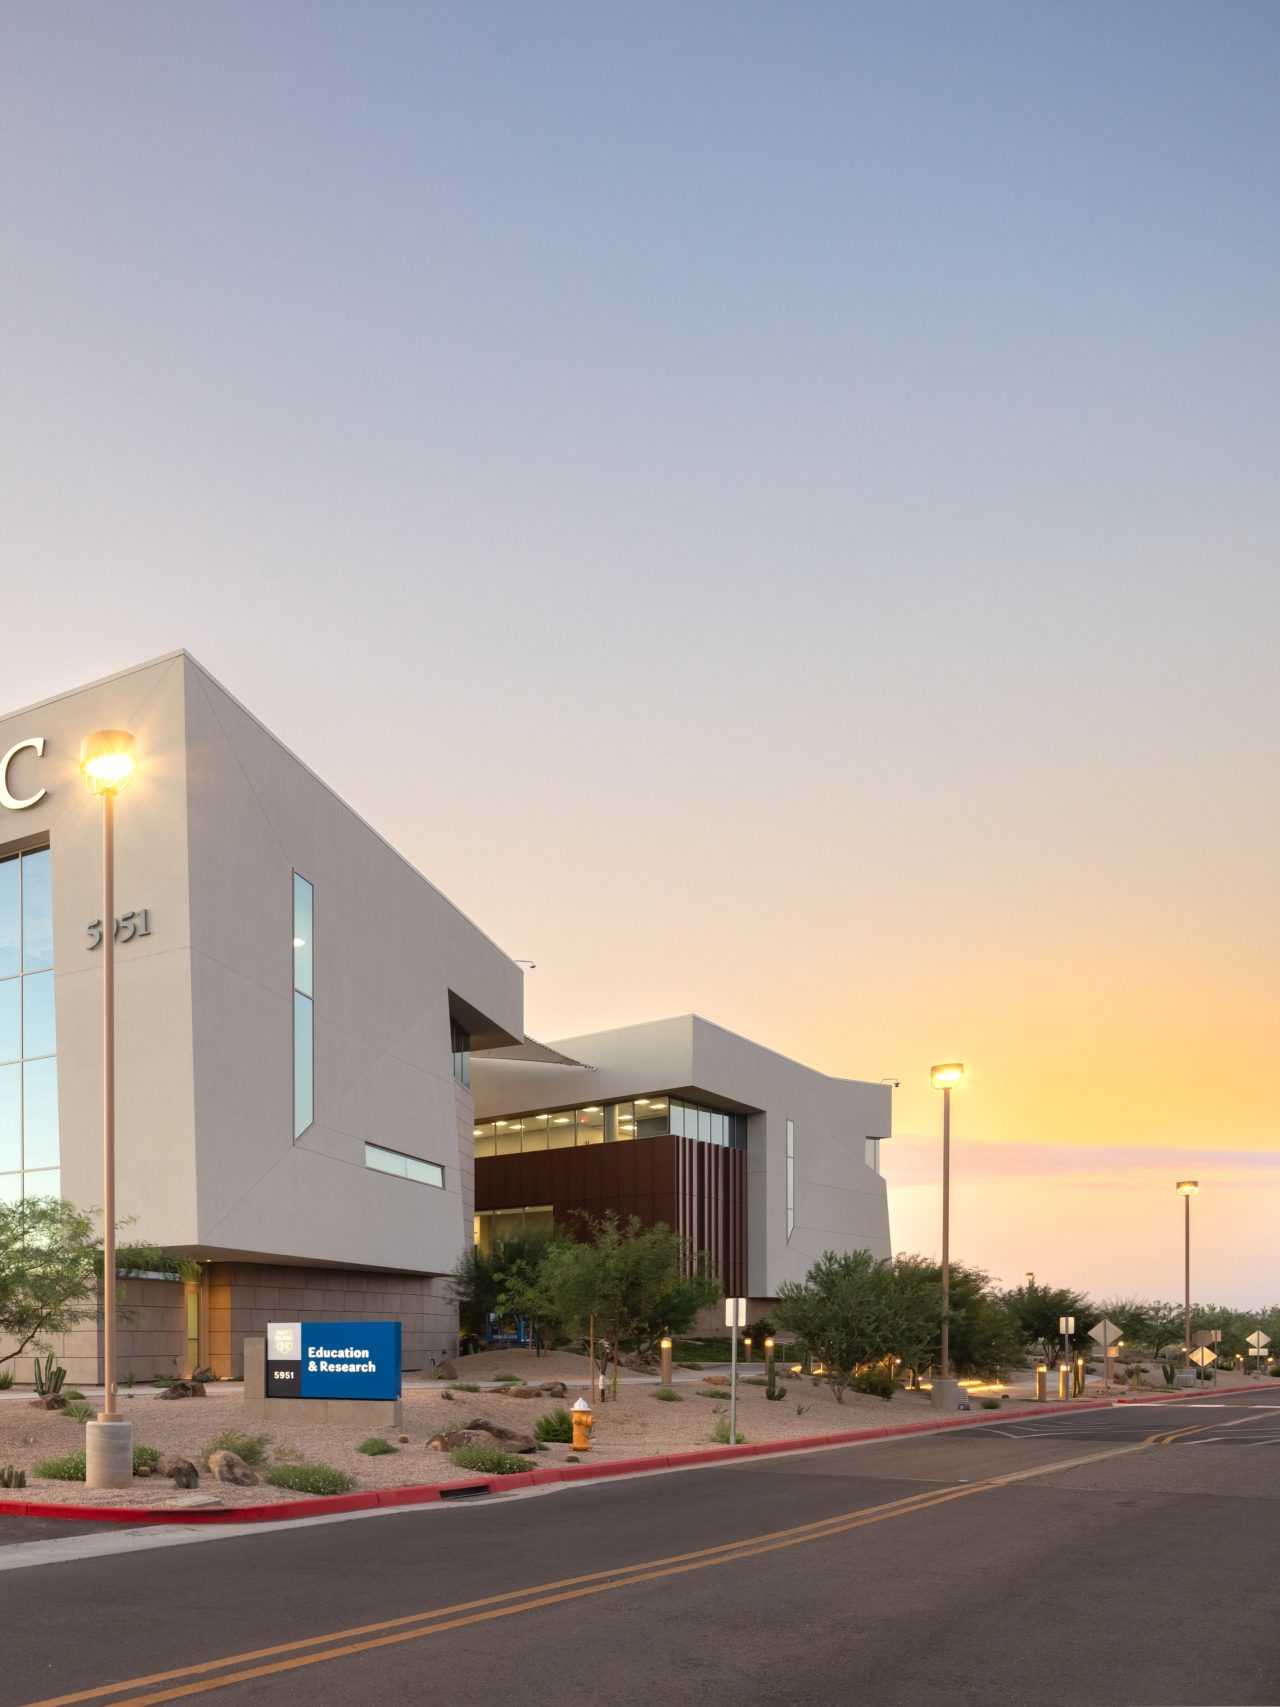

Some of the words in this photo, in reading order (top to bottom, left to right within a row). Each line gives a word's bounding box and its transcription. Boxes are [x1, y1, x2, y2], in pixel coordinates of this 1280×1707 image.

[308, 1346, 370, 1359] Education
[308, 1361, 318, 1372] &
[320, 1360, 376, 1373] Research
[274, 1371, 294, 1380] 5951
